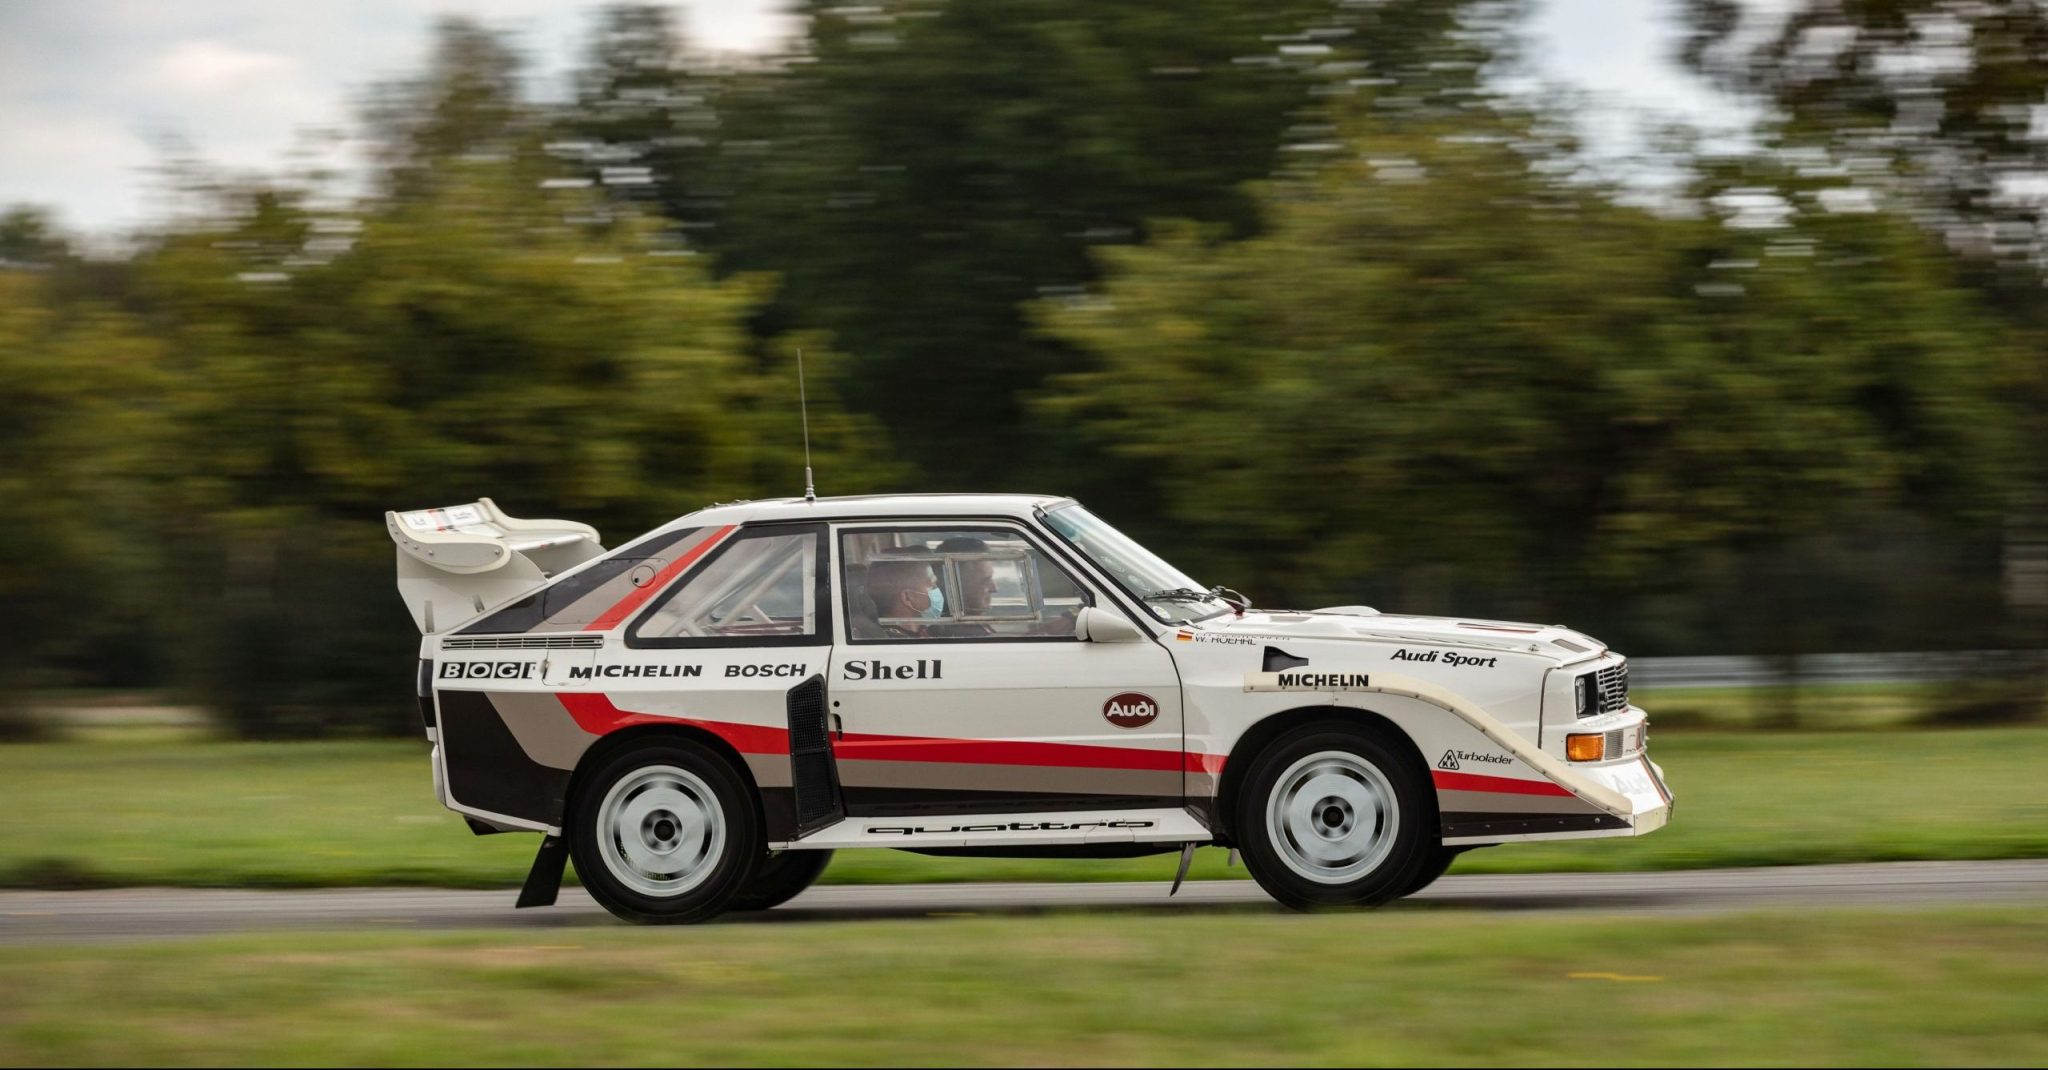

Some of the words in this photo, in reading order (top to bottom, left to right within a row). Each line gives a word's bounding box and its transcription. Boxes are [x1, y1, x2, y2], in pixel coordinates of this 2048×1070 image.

[1390, 648, 1439, 662] Audi
[1441, 651, 1498, 668] Sport
[568, 664, 703, 679] MICHELIN
[724, 663, 807, 677] BOSCH
[843, 659, 944, 680] Shell
[1278, 673, 1369, 687] MICHELIN
[1106, 701, 1155, 717] Audi
[1456, 750, 1514, 765] Turbolader
[867, 821, 1154, 835] quattro
